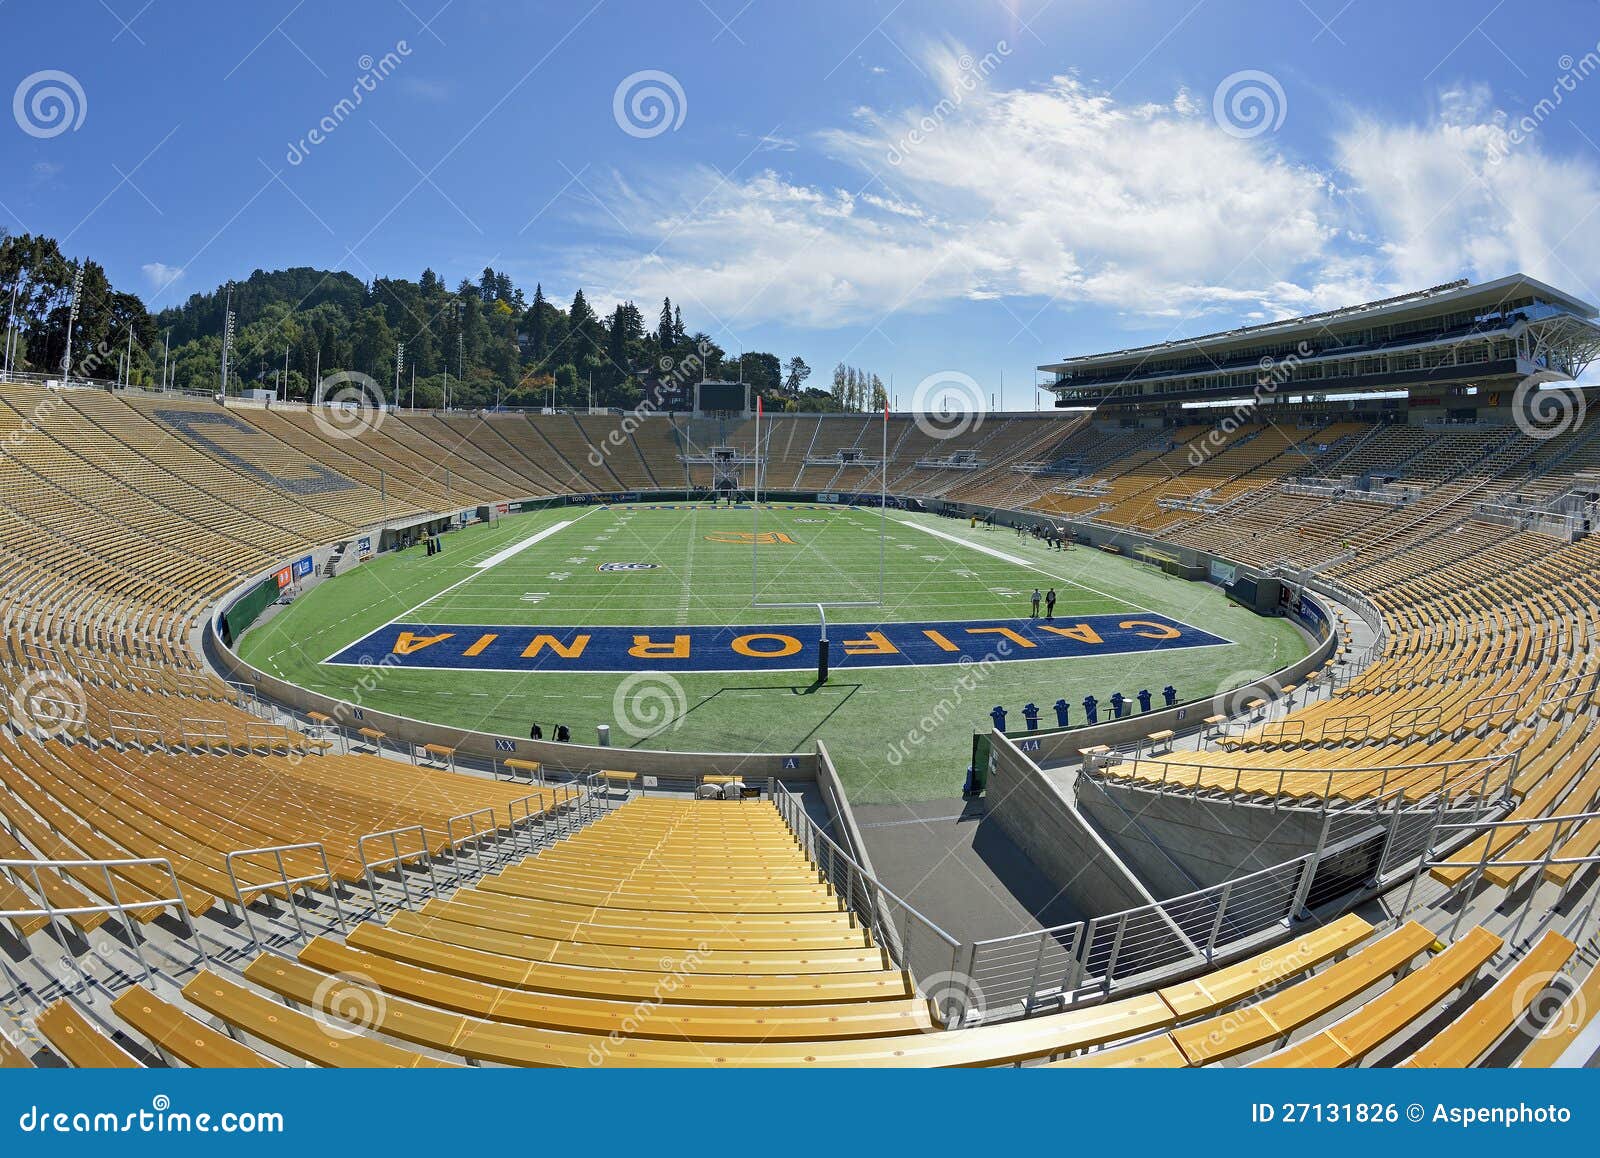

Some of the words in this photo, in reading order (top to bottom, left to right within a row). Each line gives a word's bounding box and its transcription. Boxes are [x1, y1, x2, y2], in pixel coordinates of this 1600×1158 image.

[153, 409, 359, 495] C
[391, 620, 1183, 659] CALIFORNIA
[496, 740, 515, 751] XX
[1022, 740, 1040, 750] AA
[785, 758, 795, 769] A
